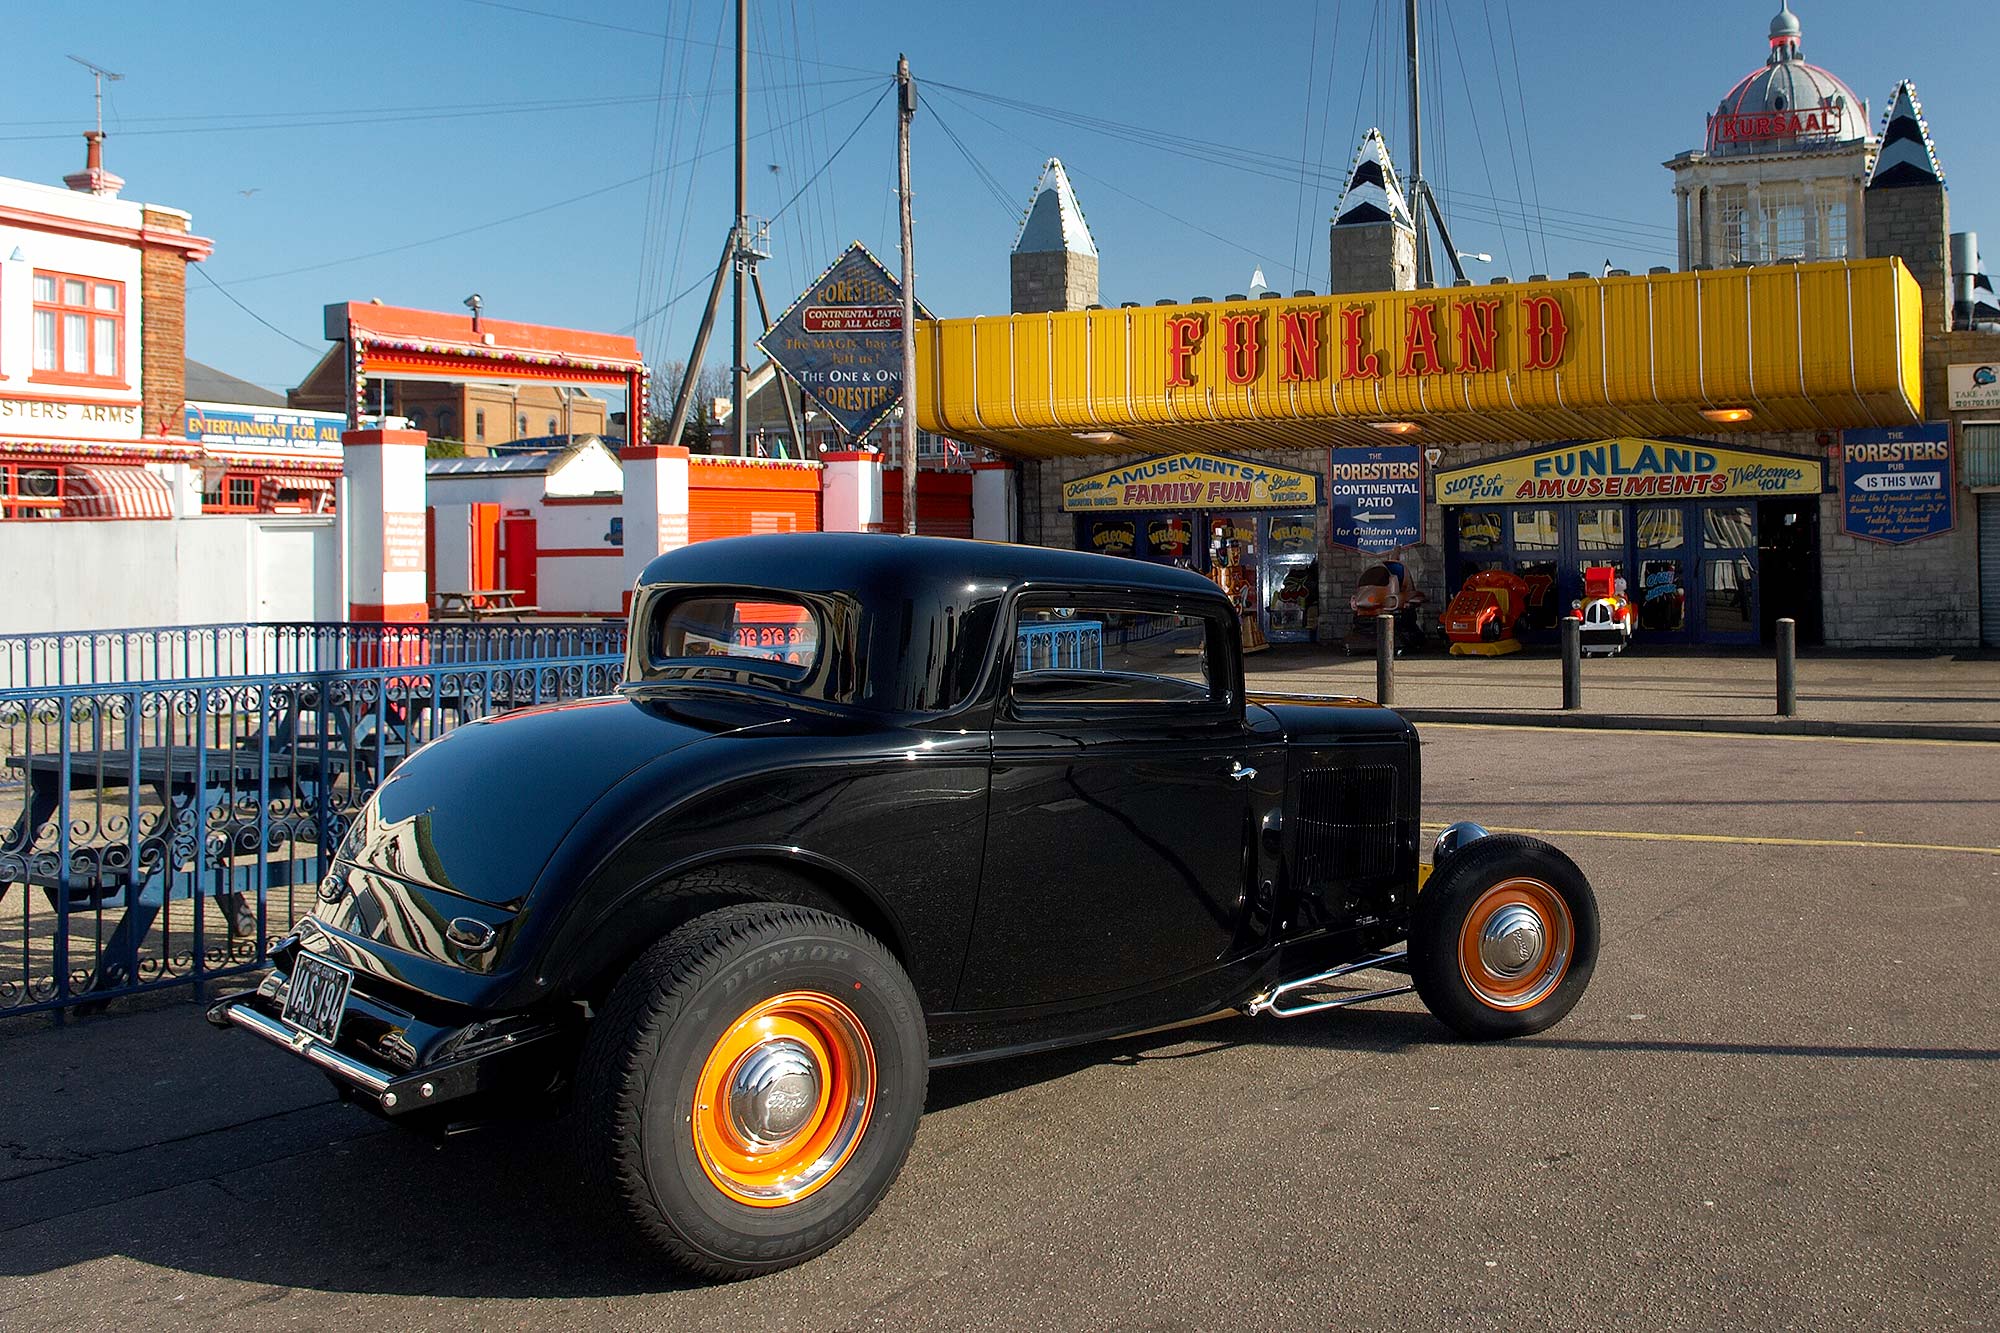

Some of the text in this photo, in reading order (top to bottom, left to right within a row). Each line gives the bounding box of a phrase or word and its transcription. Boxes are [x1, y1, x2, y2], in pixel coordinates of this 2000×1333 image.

[1723, 113, 1834, 137] KURSAAL
[817, 278, 896, 304] FORESTERS
[808, 309, 874, 319] CONTINENTAL
[821, 319, 891, 328] FOR ALL AGES
[1165, 297, 1569, 388] FUNLAND
[862, 372, 872, 382] &
[876, 369, 903, 382] ONL
[817, 386, 895, 411] FORESTERS
[2, 399, 135, 424] STERS ARMS
[188, 418, 287, 438] ENTERTAINMENT
[292, 425, 316, 439] FOR
[320, 427, 339, 441] ALL
[1534, 443, 1718, 477] FUNLAND
[1844, 441, 1949, 463] FORESTERS
[1107, 456, 1254, 488] AMUSEMENTS
[1333, 462, 1419, 480] FORESTERS
[1727, 464, 1803, 488] Welcomes
[1887, 463, 1905, 471] PUB
[1333, 484, 1419, 495] CONTINENTAL
[1444, 473, 1501, 495] SLOTS of
[1516, 473, 1728, 498] AMUSEMENTS
[1867, 475, 1935, 487] IS THIS WAY
[1123, 482, 1204, 505] FAMILY
[1206, 480, 1252, 503] FUN
[1270, 491, 1308, 502] VIDEOS
[1469, 485, 1504, 499] FUN
[1357, 497, 1394, 507] PATIO
[1872, 505, 1887, 513] Old
[1093, 530, 1135, 547] WELCOME
[1148, 529, 1191, 545] WELCOME
[1272, 526, 1314, 541] WELCOME
[1336, 527, 1417, 536] for Children with
[1357, 537, 1398, 546] Parents!
[722, 945, 850, 993] DUNLOP
[290, 968, 320, 1014] VAS
[315, 980, 343, 1027] 194
[766, 1090, 809, 1109] Ford
